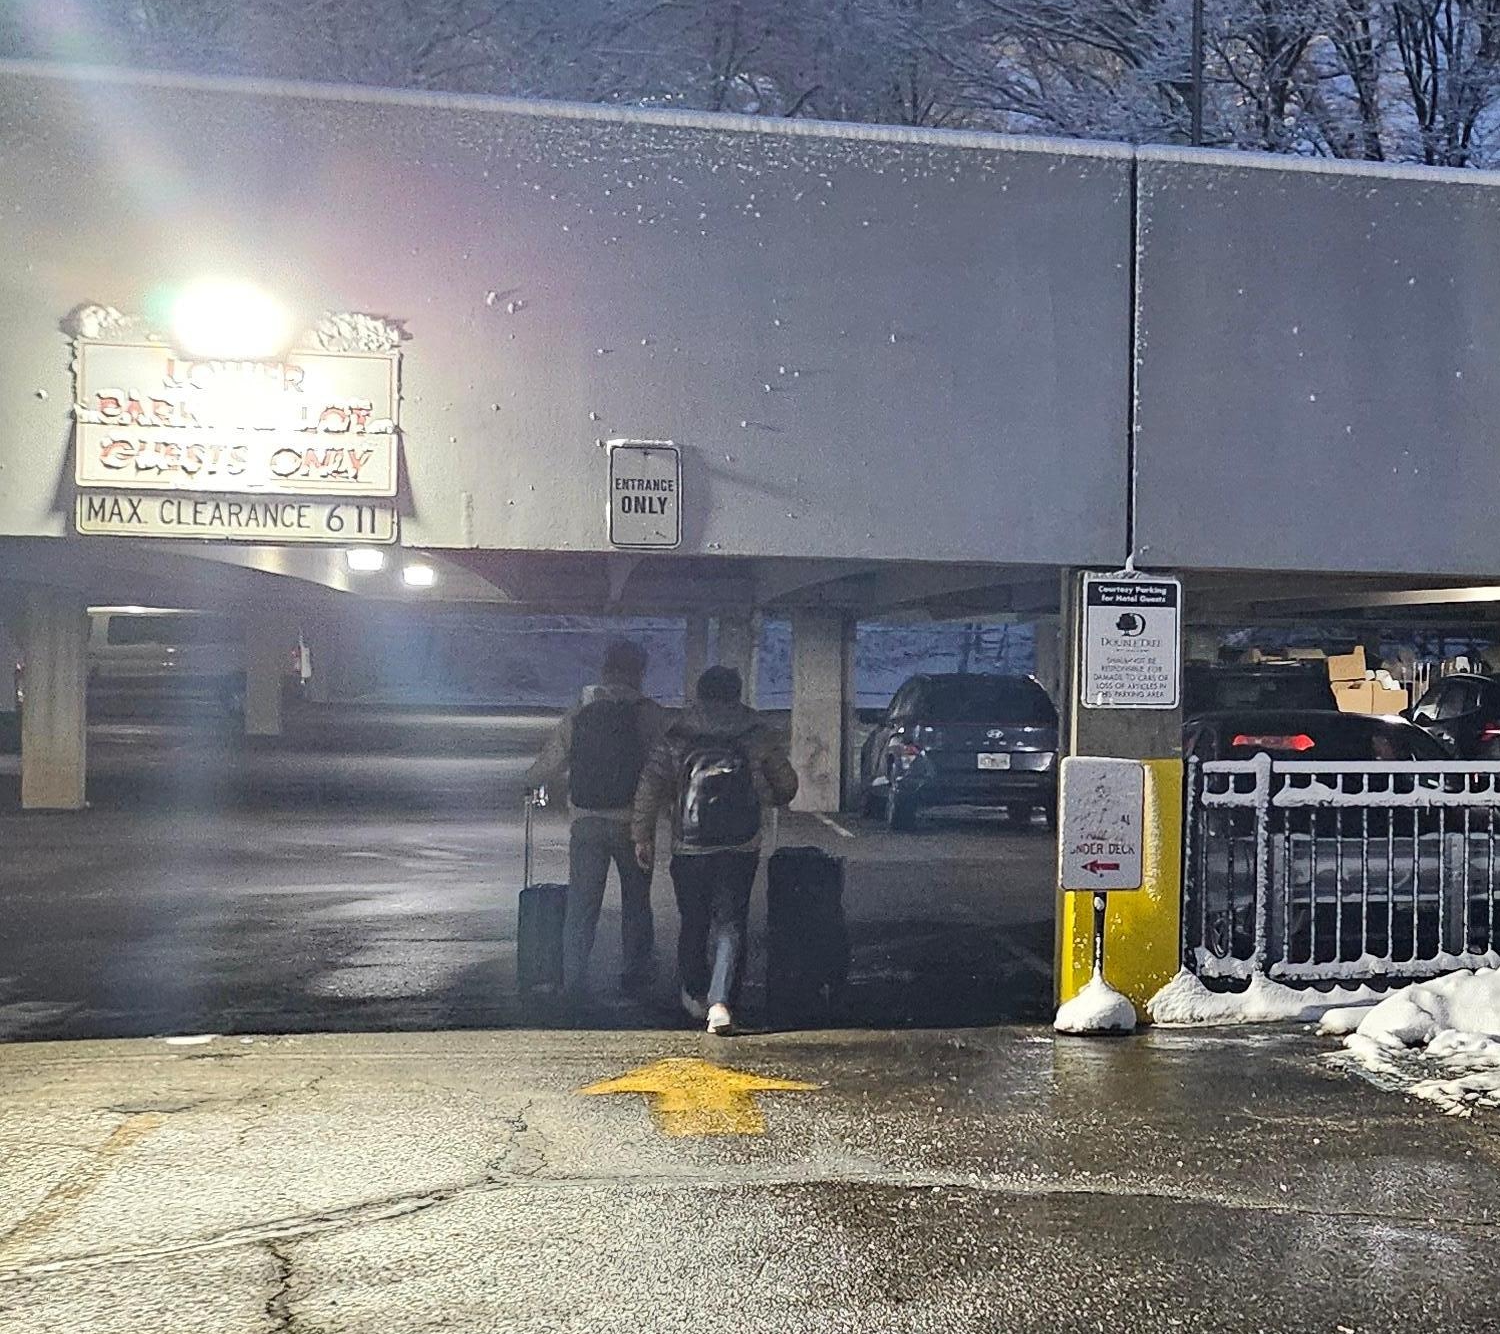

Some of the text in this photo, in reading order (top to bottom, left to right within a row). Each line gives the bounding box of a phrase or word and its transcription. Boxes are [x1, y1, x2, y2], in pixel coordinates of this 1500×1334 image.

[99, 439, 374, 483] GUESTS ONLY
[615, 477, 674, 492] ENTRANCE
[160, 498, 311, 529] CLEARANCE
[621, 495, 668, 515] ONLY
[1098, 585, 1167, 595] Courtesy Parking
[1101, 594, 1166, 603] for Hotel Guests
